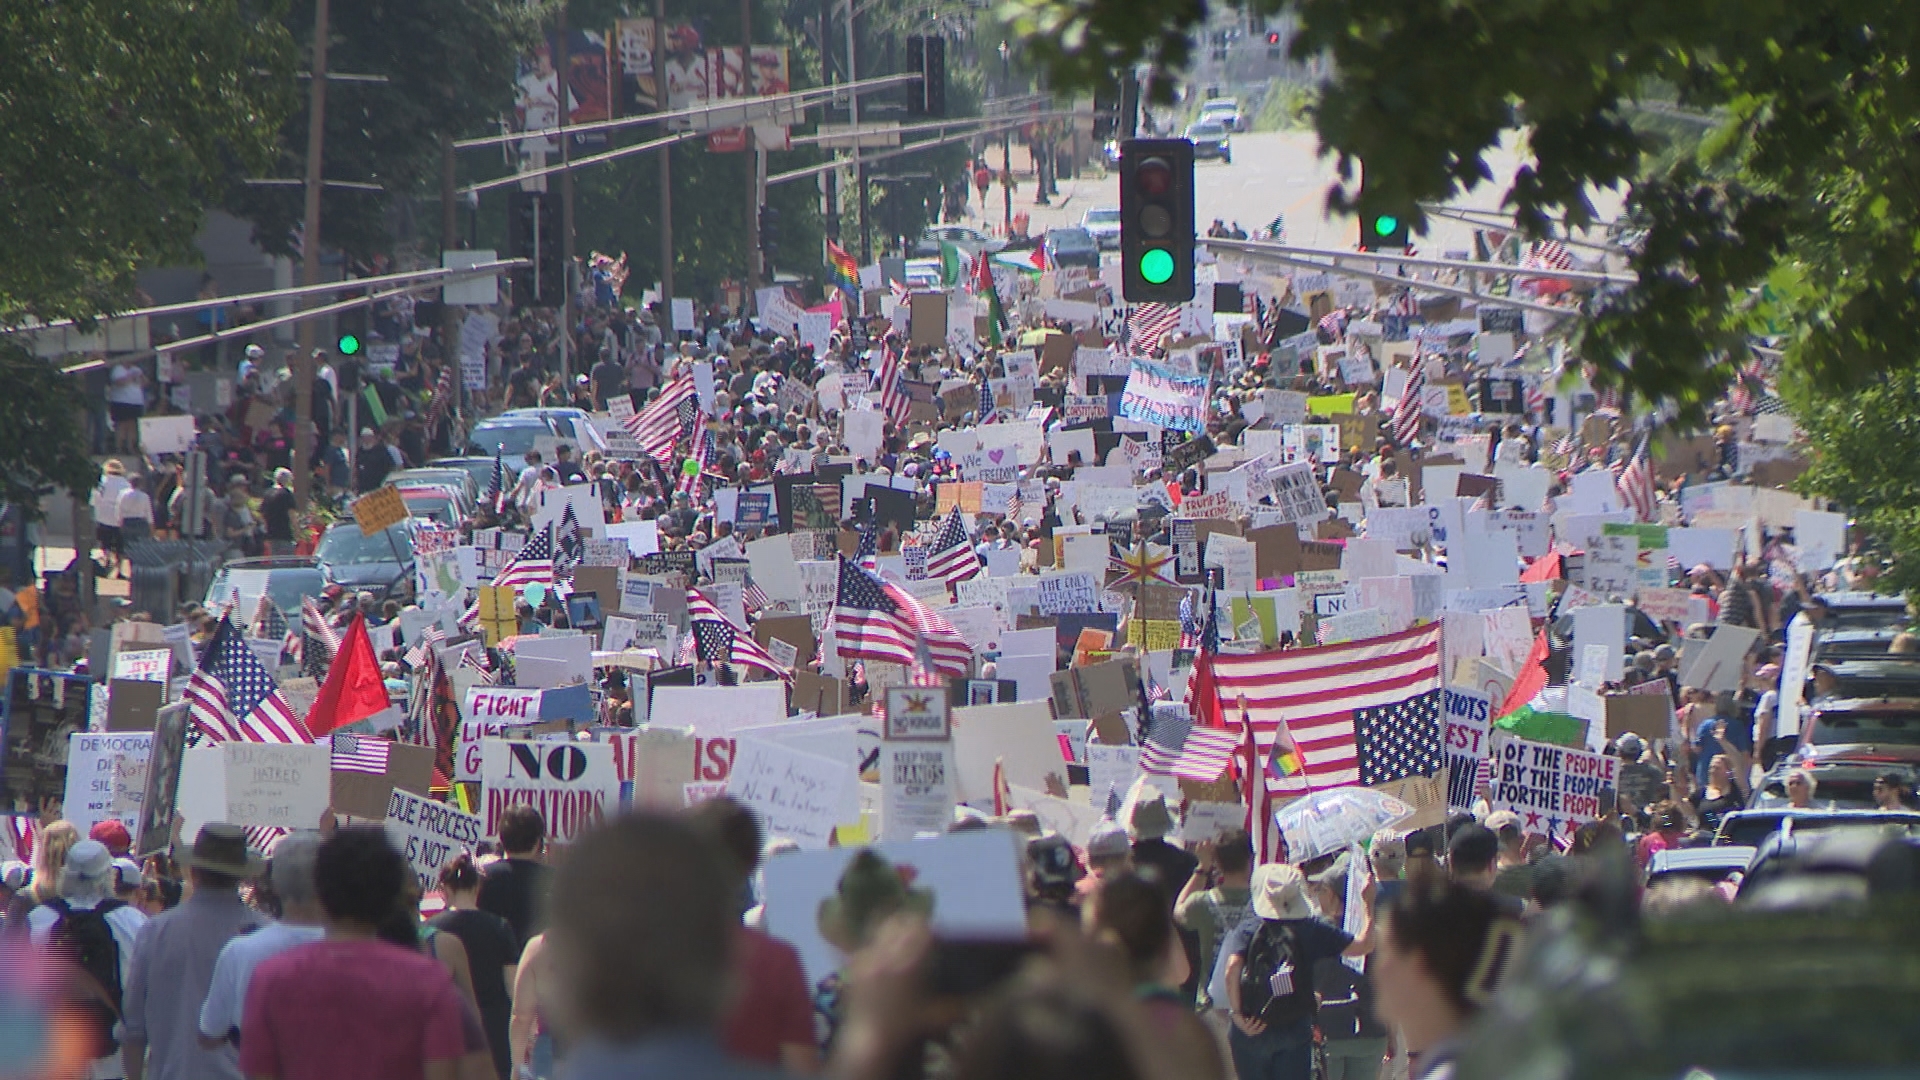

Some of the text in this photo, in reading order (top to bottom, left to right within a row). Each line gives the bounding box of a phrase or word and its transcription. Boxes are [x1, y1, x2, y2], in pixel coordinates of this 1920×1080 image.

[962, 455, 982, 468] We
[1185, 491, 1226, 511] TRUMP IS
[914, 521, 941, 534] RIS
[1040, 578, 1061, 592] THE
[1485, 613, 1513, 633] NO
[473, 694, 533, 718] FIGHT
[1444, 689, 1489, 722] RIOTS
[80, 738, 152, 752] DEMOCRA
[1446, 723, 1484, 753] EST
[505, 742, 588, 781] NO
[1504, 743, 1614, 780] OF THE PEOPLE
[253, 767, 302, 782] HATRED
[893, 764, 945, 784] HANDS
[1502, 763, 1527, 784] BY
[1530, 768, 1560, 790] THE
[1563, 793, 1598, 817] PEOPL
[388, 792, 481, 846] DUE PROCESS
[405, 836, 451, 868] IS NOT
